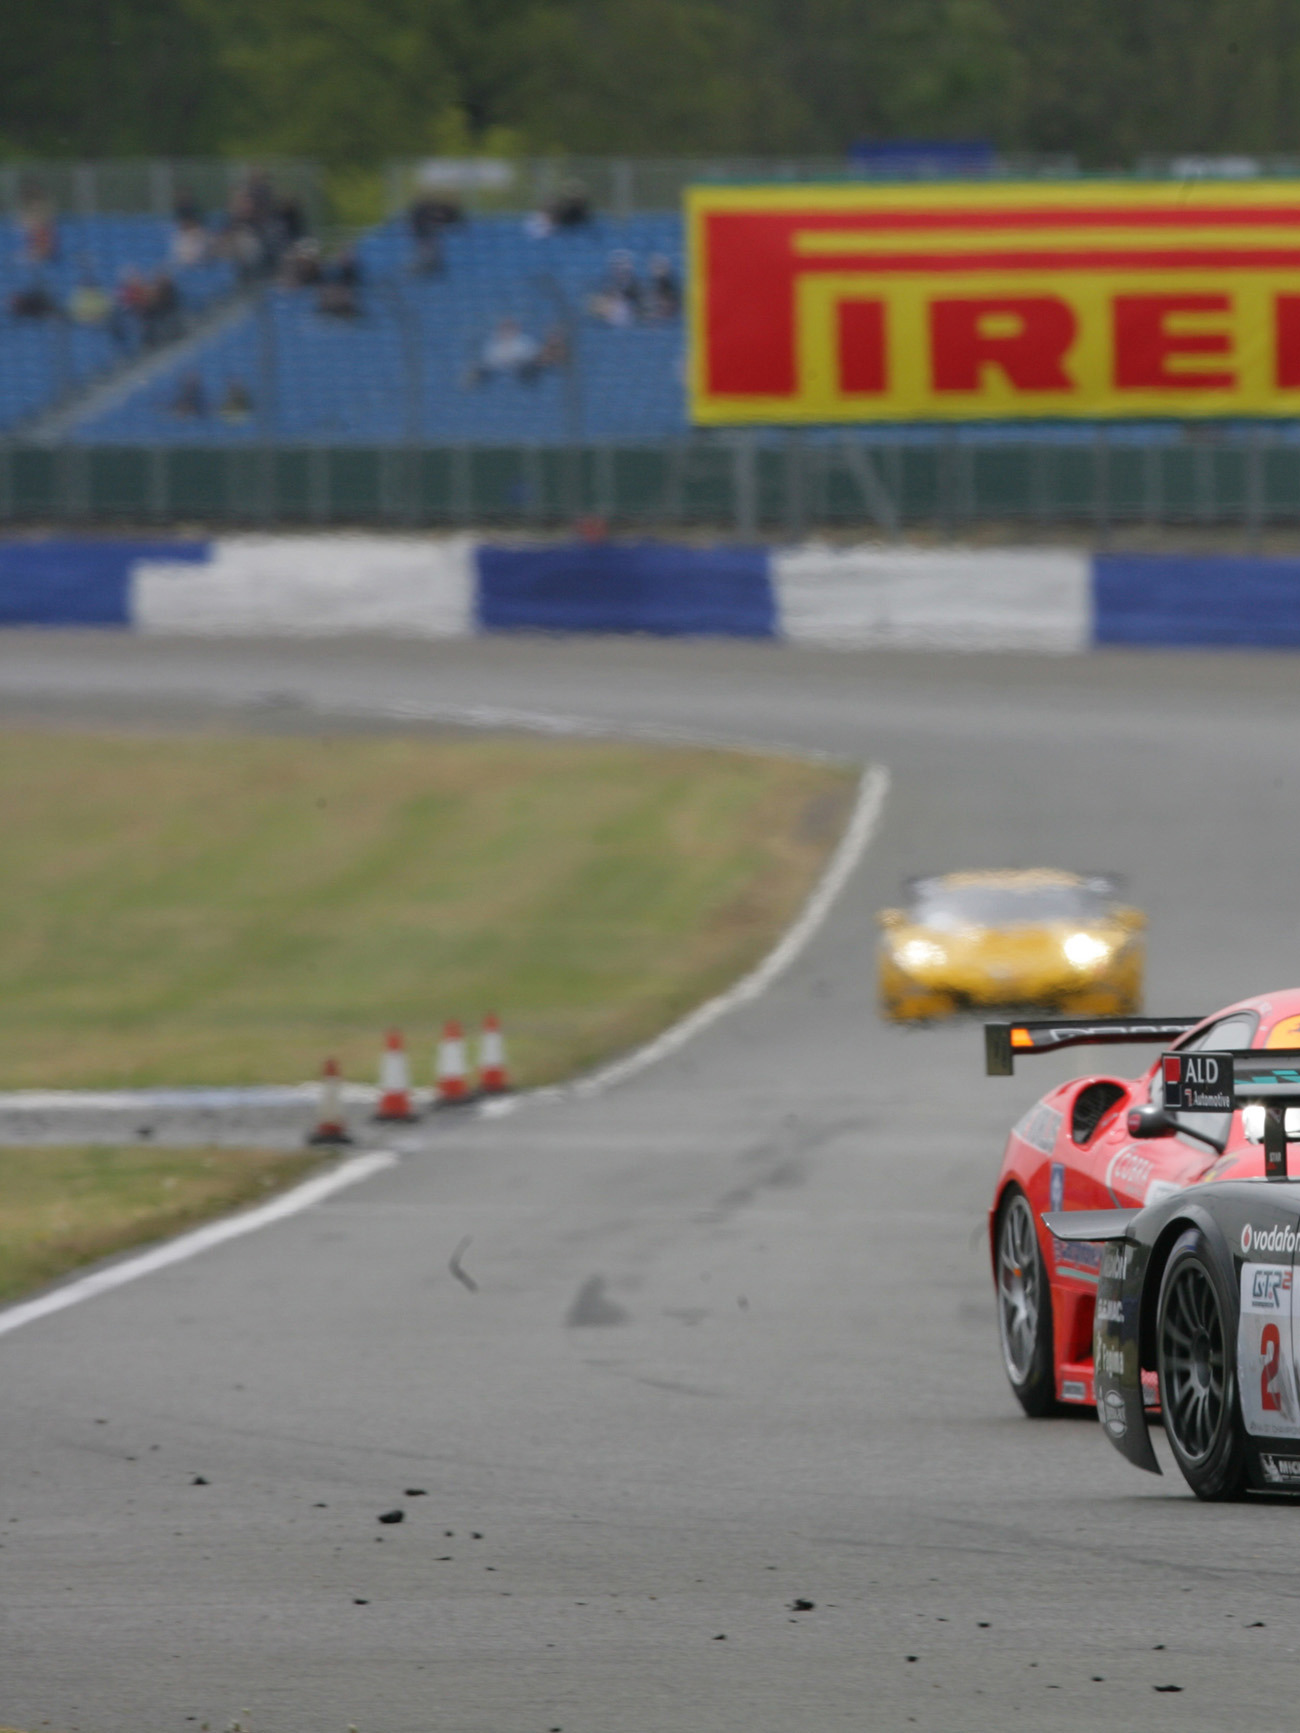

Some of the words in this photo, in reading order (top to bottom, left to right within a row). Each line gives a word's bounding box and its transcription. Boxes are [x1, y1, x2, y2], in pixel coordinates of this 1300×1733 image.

[1185, 1058, 1219, 1084] ALD
[1193, 1090, 1231, 1108] Automotive
[1260, 1323, 1282, 1411] 2
